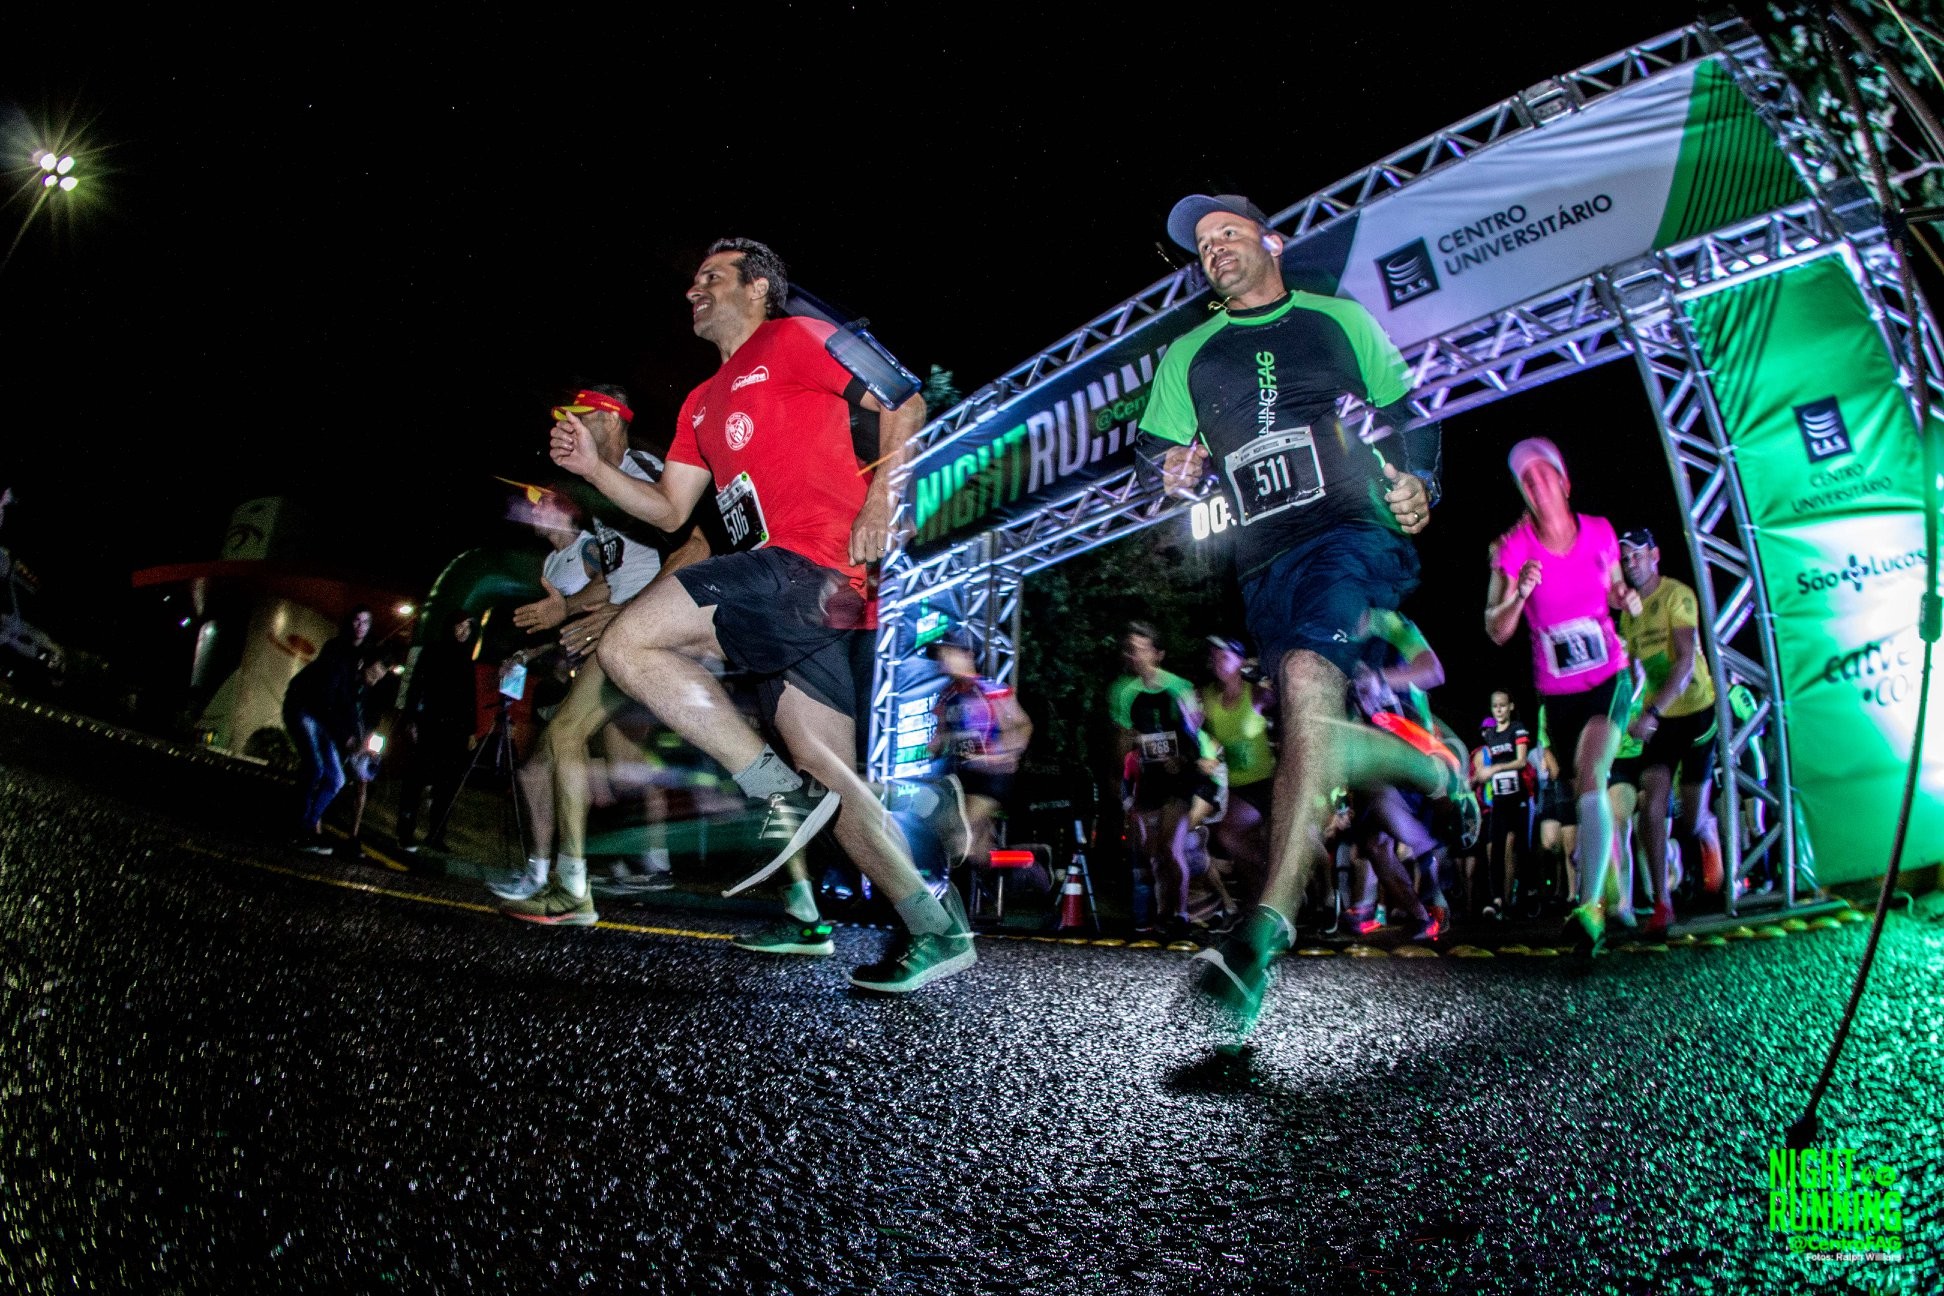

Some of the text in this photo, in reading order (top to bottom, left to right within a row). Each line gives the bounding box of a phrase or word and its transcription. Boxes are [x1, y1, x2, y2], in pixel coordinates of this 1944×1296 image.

[1437, 205, 1527, 254] CENTRO
[1444, 194, 1613, 275] UNIVERSITÁRIO
[916, 423, 1028, 545] NIGHT
[1254, 454, 1291, 496] 511
[1809, 463, 1864, 488] CENTRO
[723, 502, 750, 546] 506
[1796, 567, 1839, 595] São
